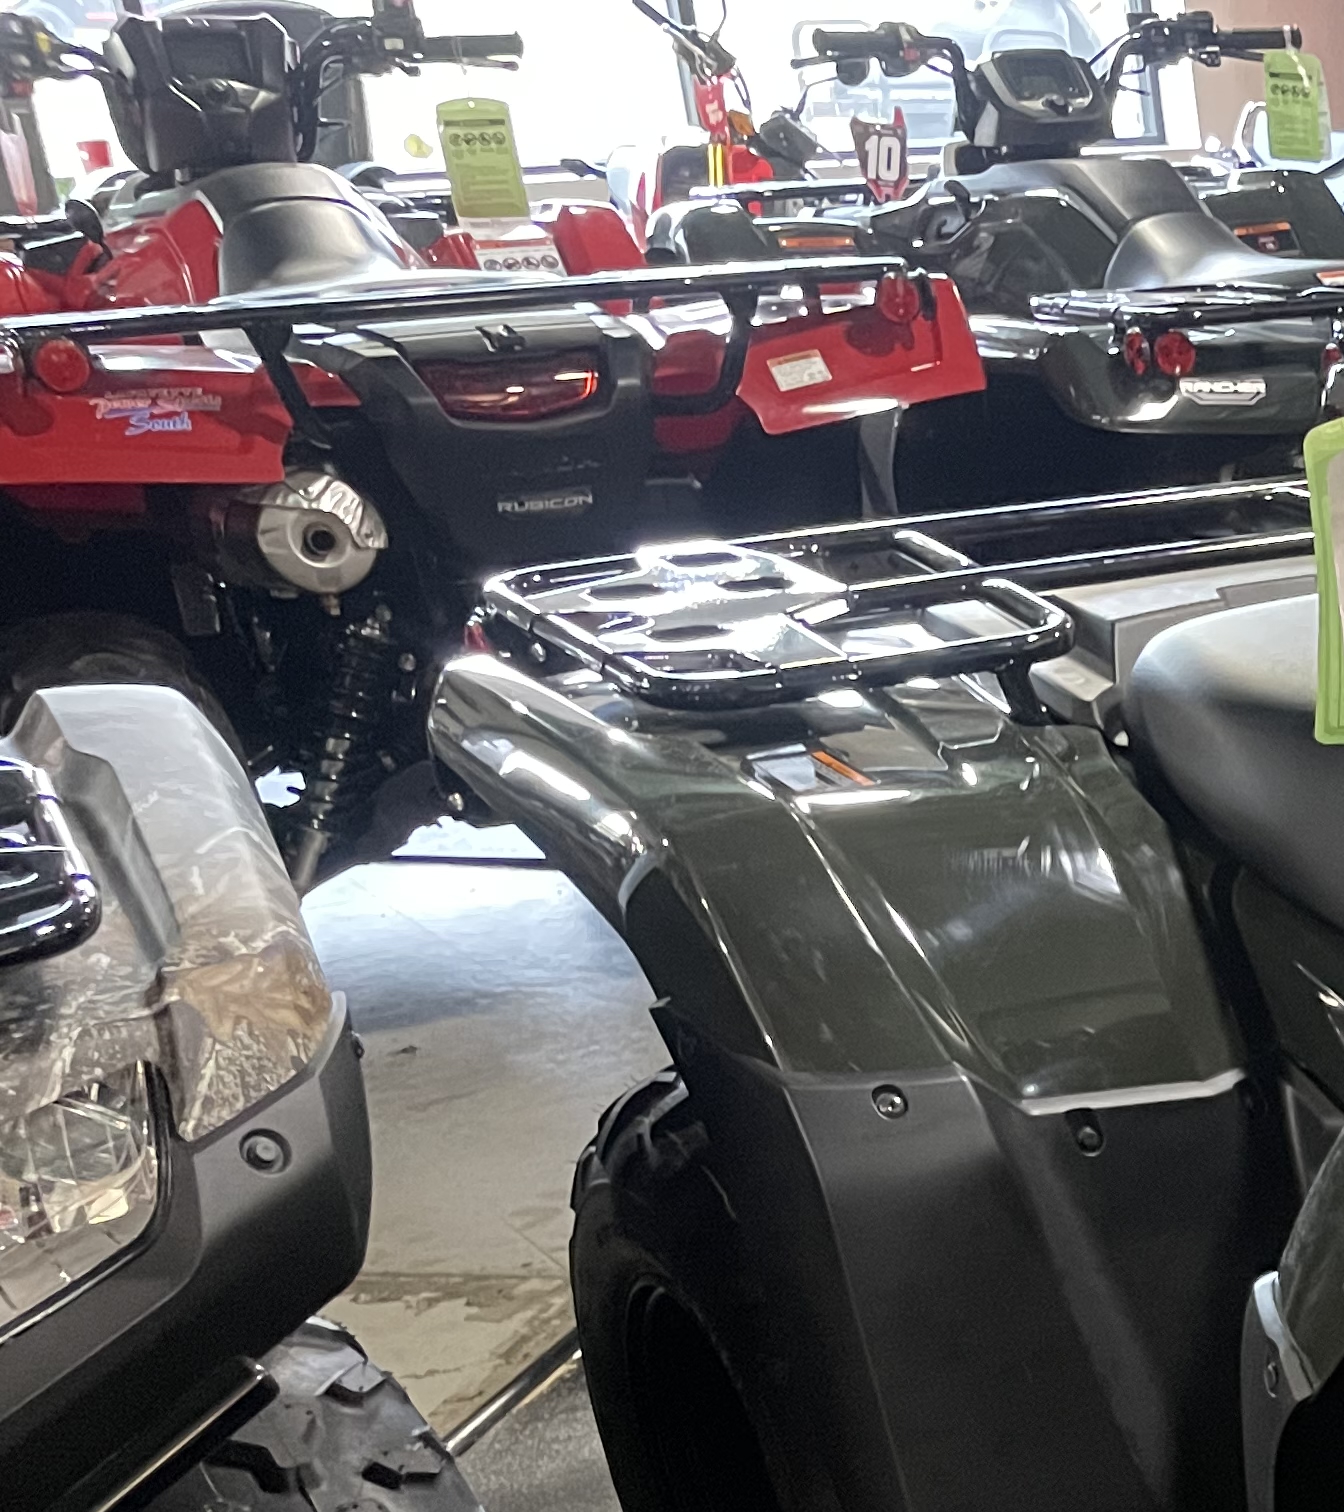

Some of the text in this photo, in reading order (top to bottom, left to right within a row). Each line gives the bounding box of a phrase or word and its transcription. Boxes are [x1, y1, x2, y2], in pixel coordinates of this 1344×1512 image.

[865, 135, 901, 181] 10
[1180, 380, 1266, 394] RANCHER
[125, 411, 192, 435] South
[497, 494, 593, 513] RUBICON
